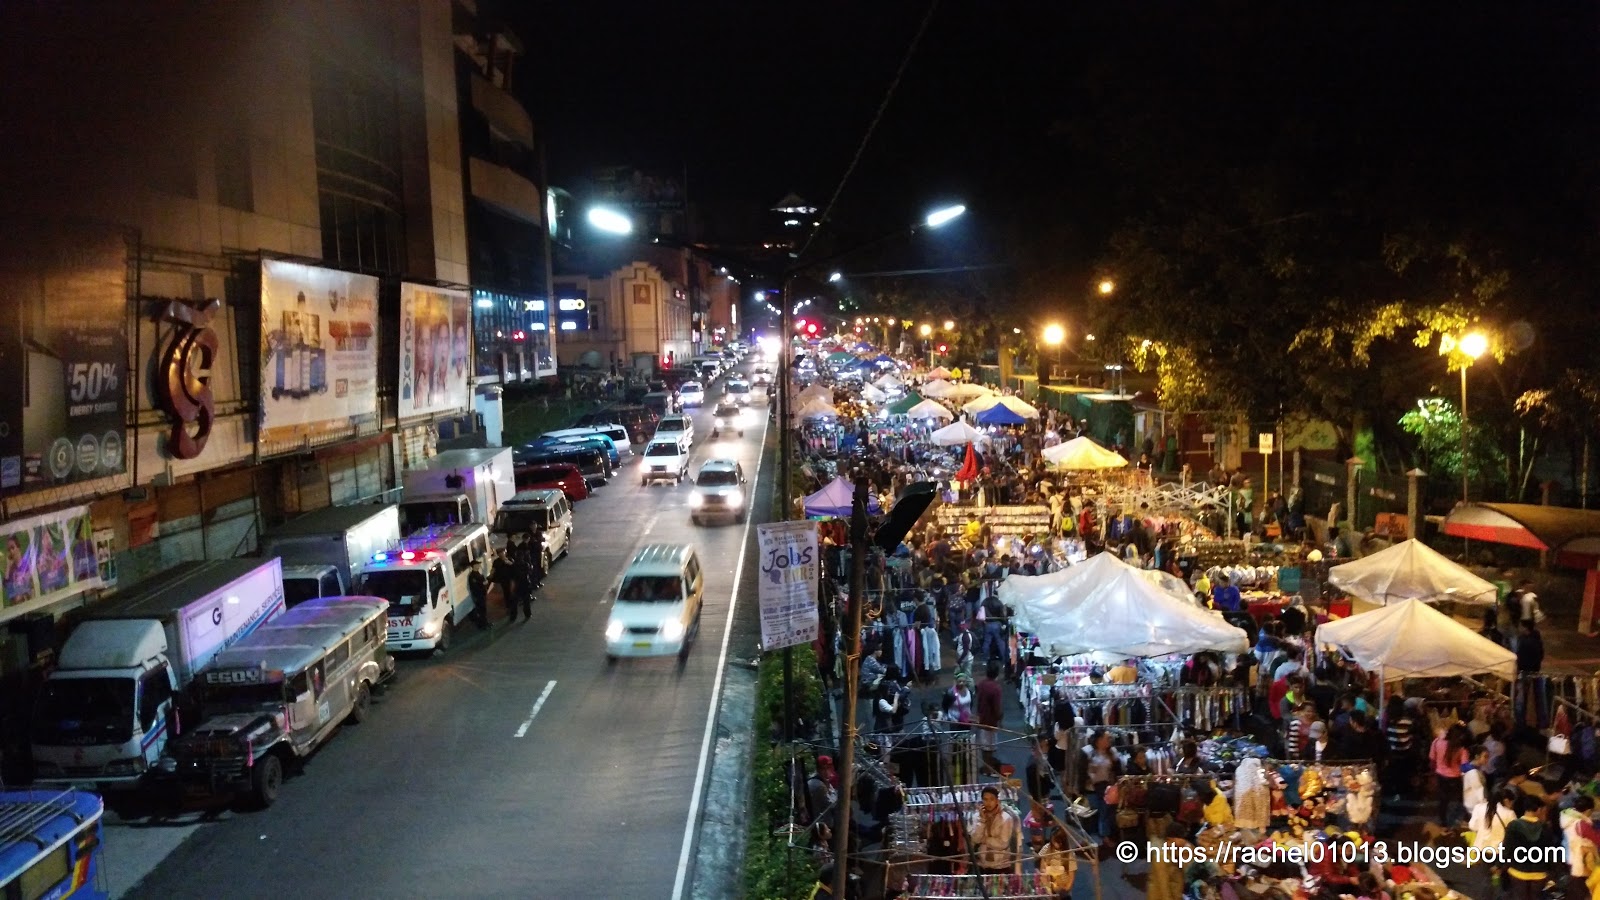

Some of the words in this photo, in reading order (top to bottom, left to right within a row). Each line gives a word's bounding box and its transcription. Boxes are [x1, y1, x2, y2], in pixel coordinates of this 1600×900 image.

[70, 362, 118, 402] 50%
[69, 404, 94, 418] ENERGY
[212, 607, 222, 626] G
